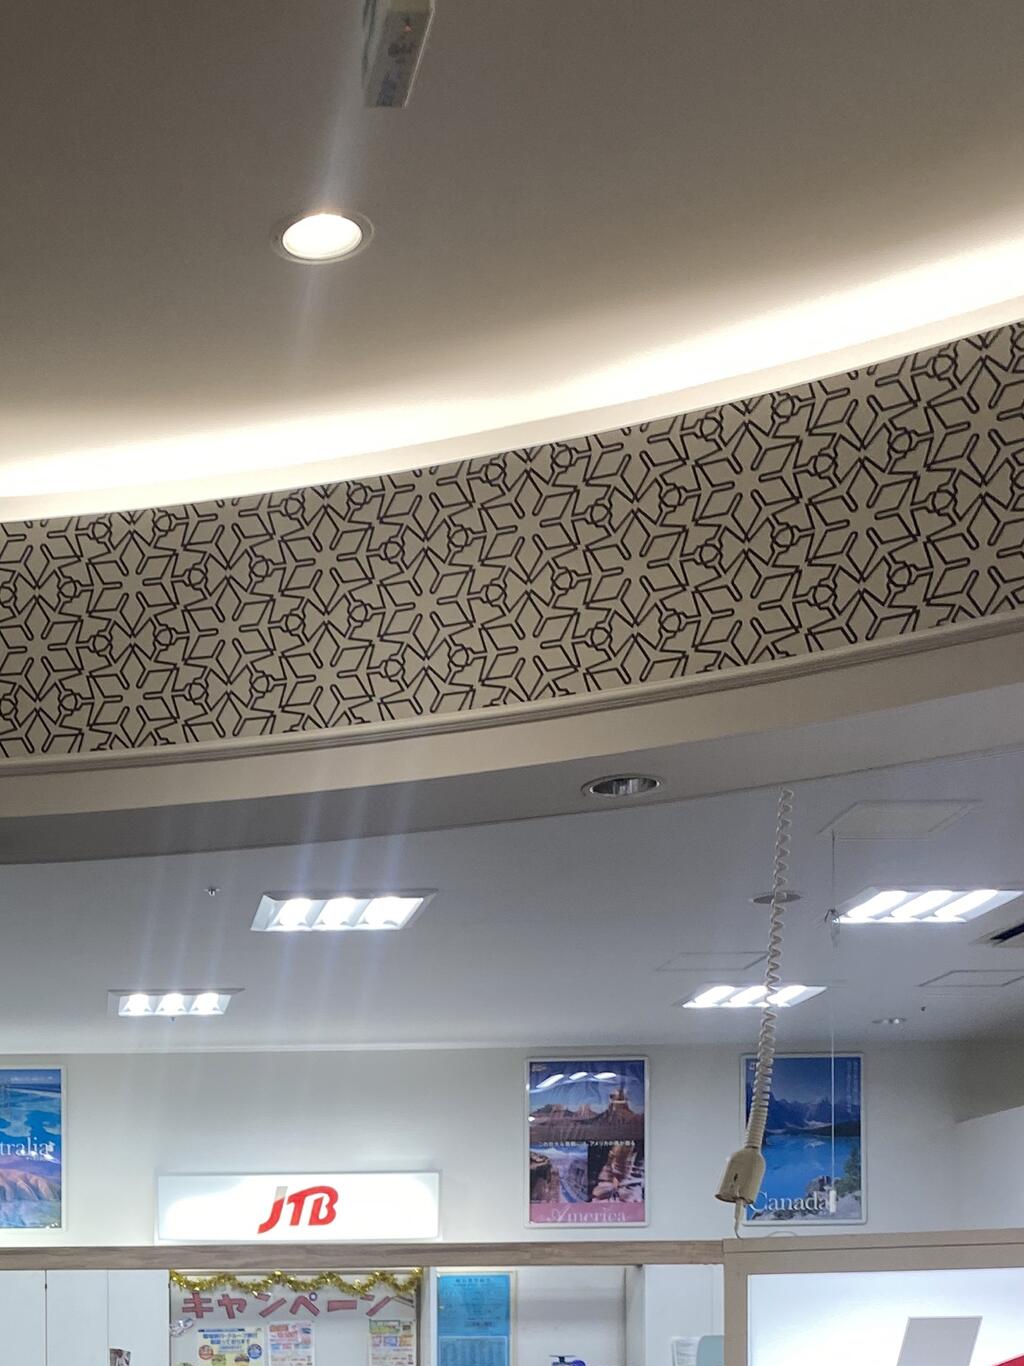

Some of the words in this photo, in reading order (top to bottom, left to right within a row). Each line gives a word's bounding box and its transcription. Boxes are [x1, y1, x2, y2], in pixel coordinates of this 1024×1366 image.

[257, 1185, 339, 1234] JTB
[749, 1190, 830, 1212] Canada
[546, 1206, 627, 1223] America
[182, 1290, 392, 1320] キャンペーン
